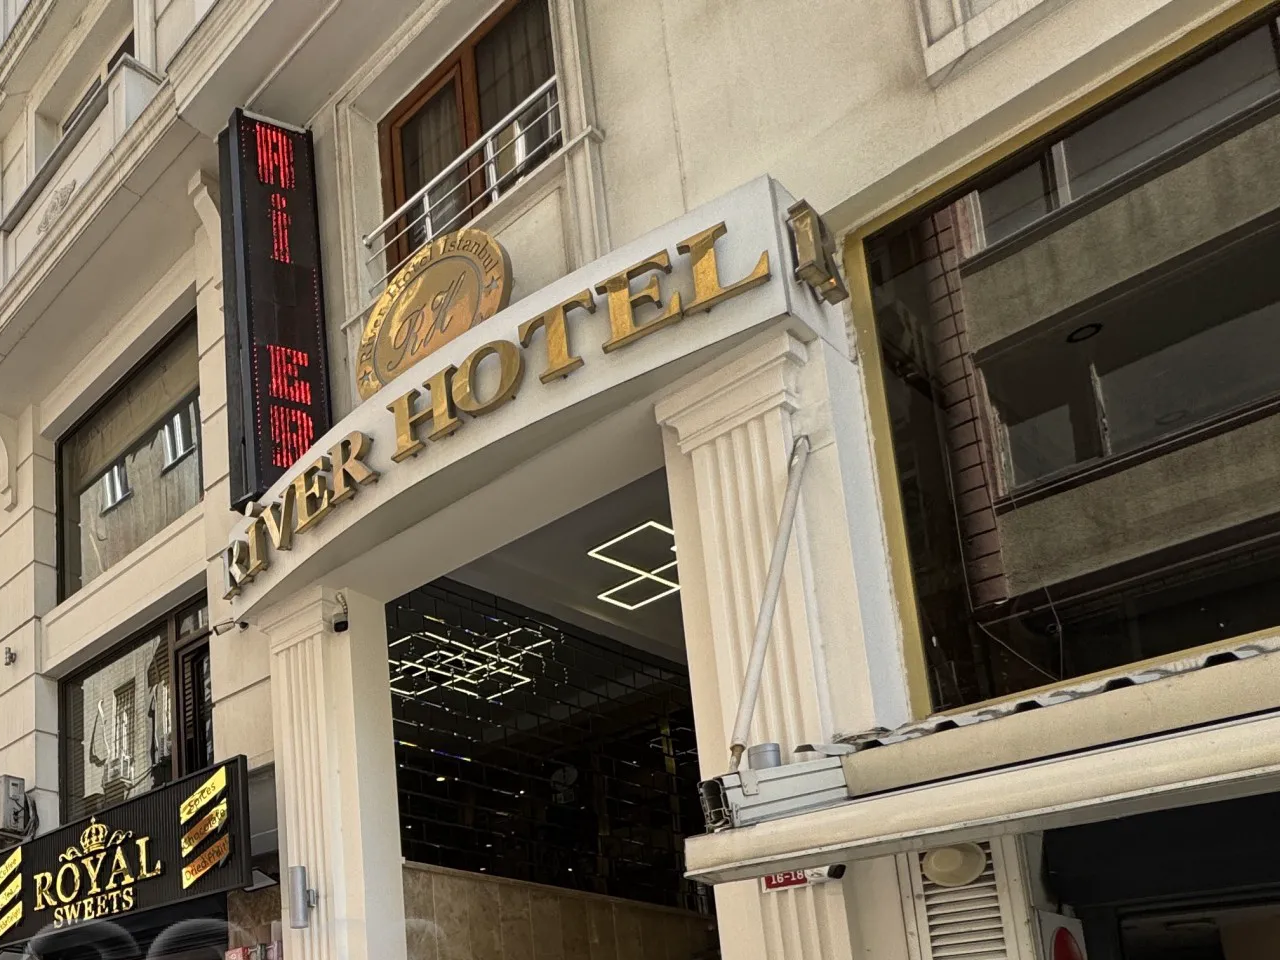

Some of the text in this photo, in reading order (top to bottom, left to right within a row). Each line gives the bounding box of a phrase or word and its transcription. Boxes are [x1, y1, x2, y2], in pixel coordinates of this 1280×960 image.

[387, 221, 772, 463] HOTEL
[33, 836, 162, 912] ROYAL
[771, 869, 804, 885] 16-18
[53, 886, 135, 929] SWEETS
